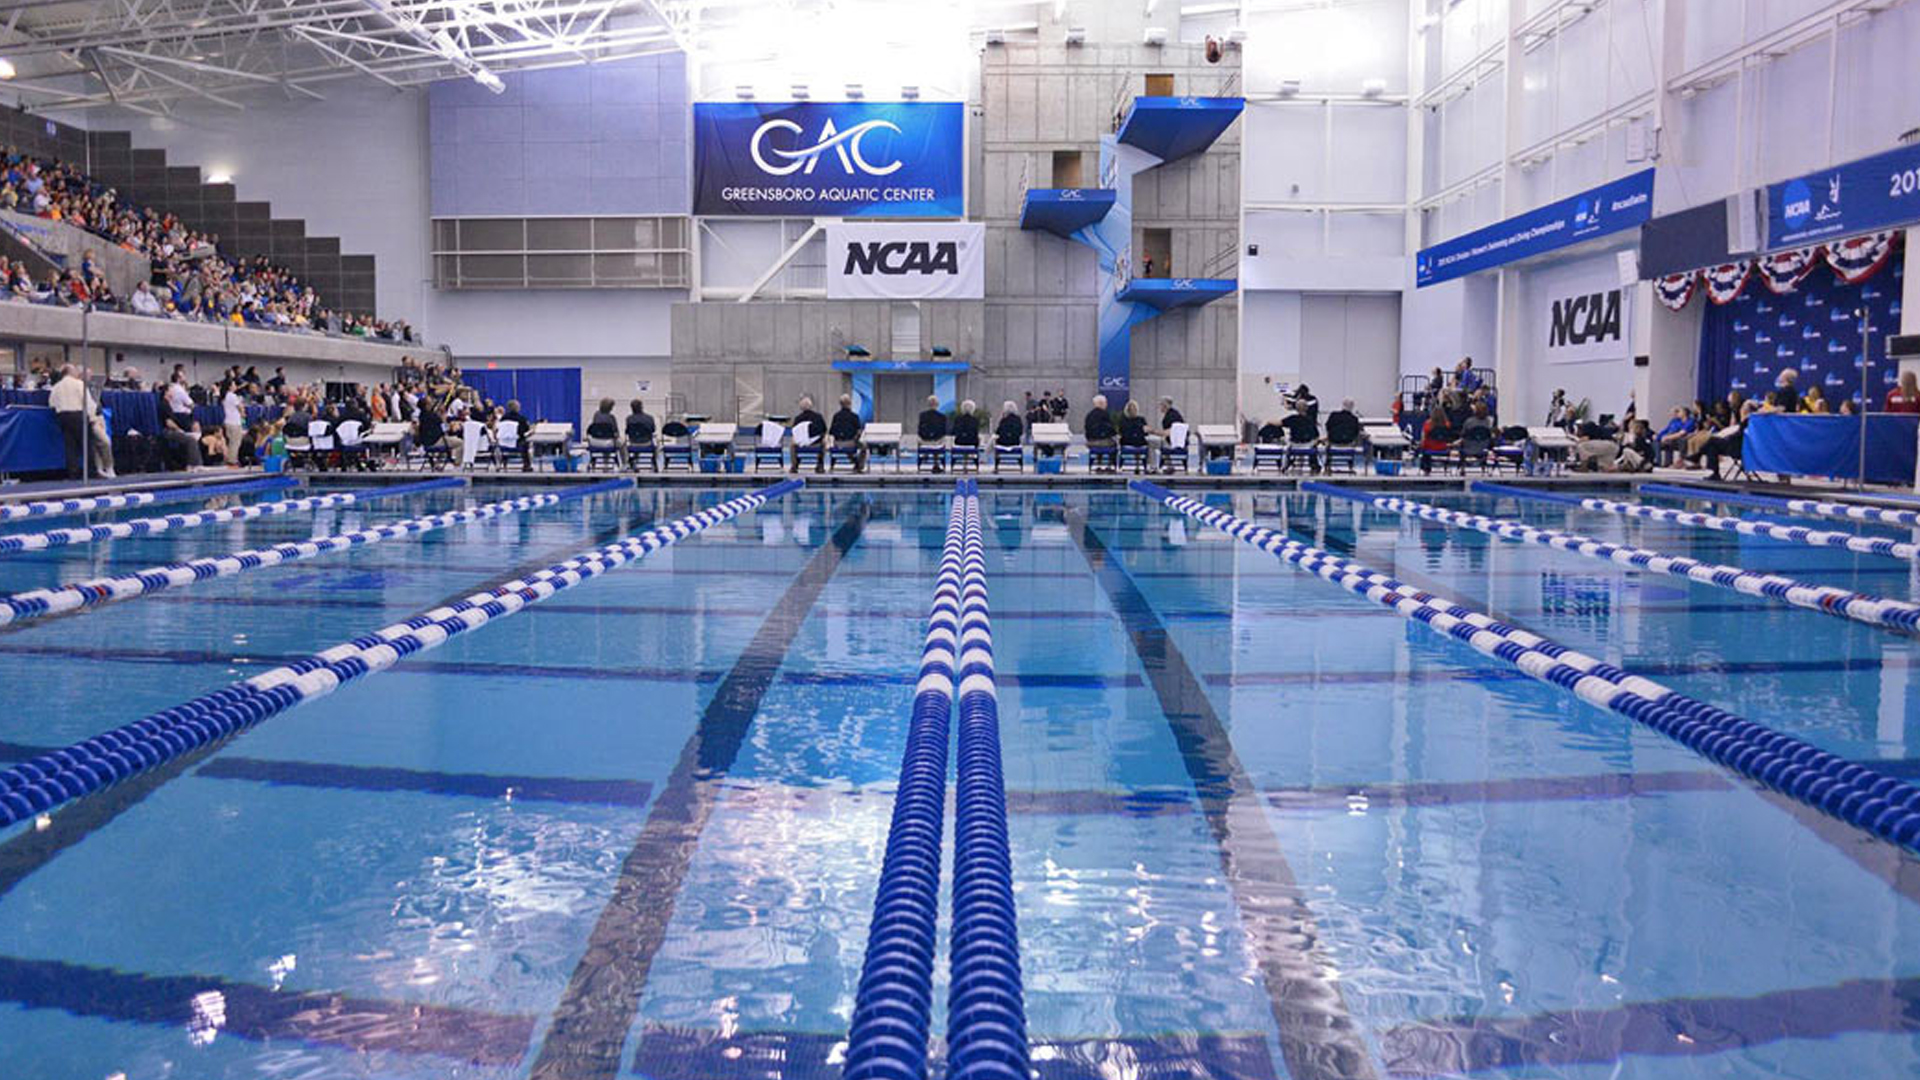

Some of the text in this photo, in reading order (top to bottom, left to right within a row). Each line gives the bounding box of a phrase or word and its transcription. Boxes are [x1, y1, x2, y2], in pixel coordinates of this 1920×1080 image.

[751, 117, 902, 176] GAC
[721, 186, 936, 202] GREENSBORO AQUATIC CENTER
[843, 241, 959, 276] NCAA
[1549, 288, 1622, 348] NCAA
